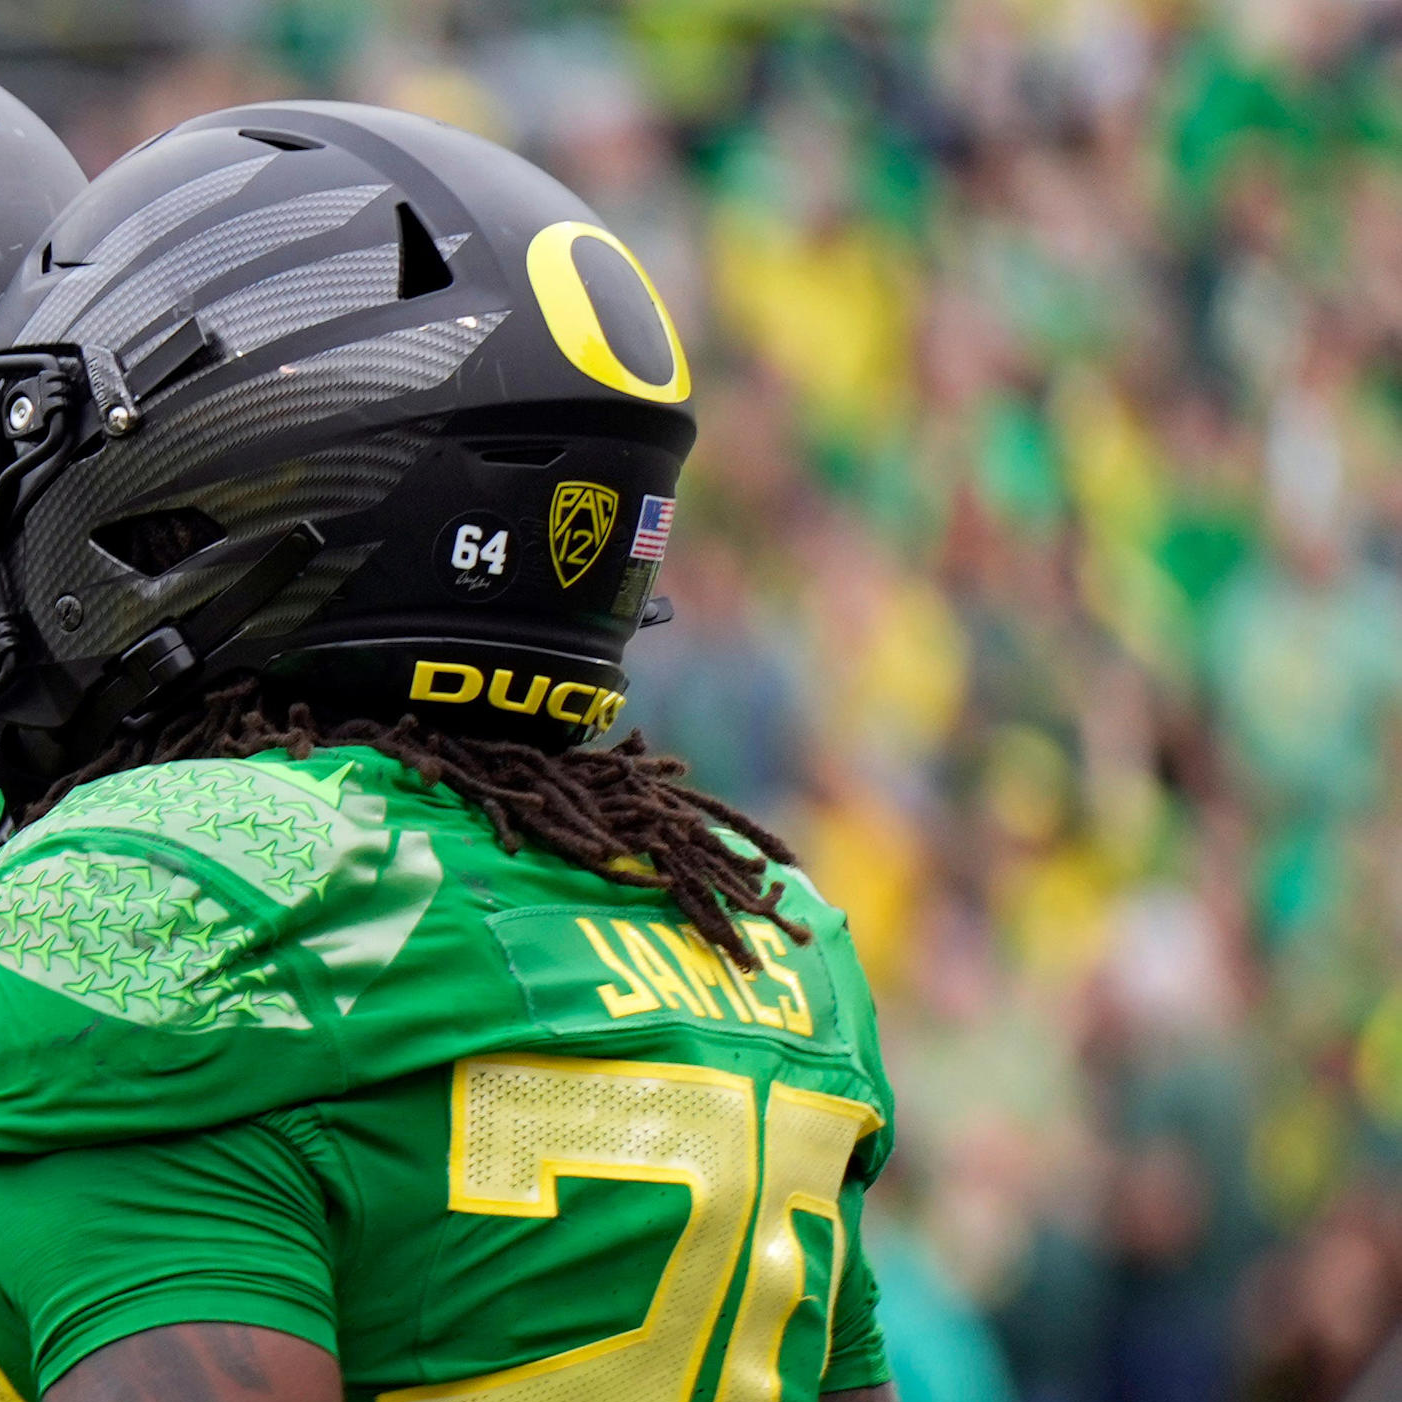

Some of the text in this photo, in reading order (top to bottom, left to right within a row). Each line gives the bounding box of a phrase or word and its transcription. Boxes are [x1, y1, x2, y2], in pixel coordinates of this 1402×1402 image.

[555, 487, 613, 548] PAC
[558, 528, 594, 565] 12
[451, 524, 509, 575] 64
[409, 660, 627, 733] DUCK
[575, 917, 813, 1037] JAMES
